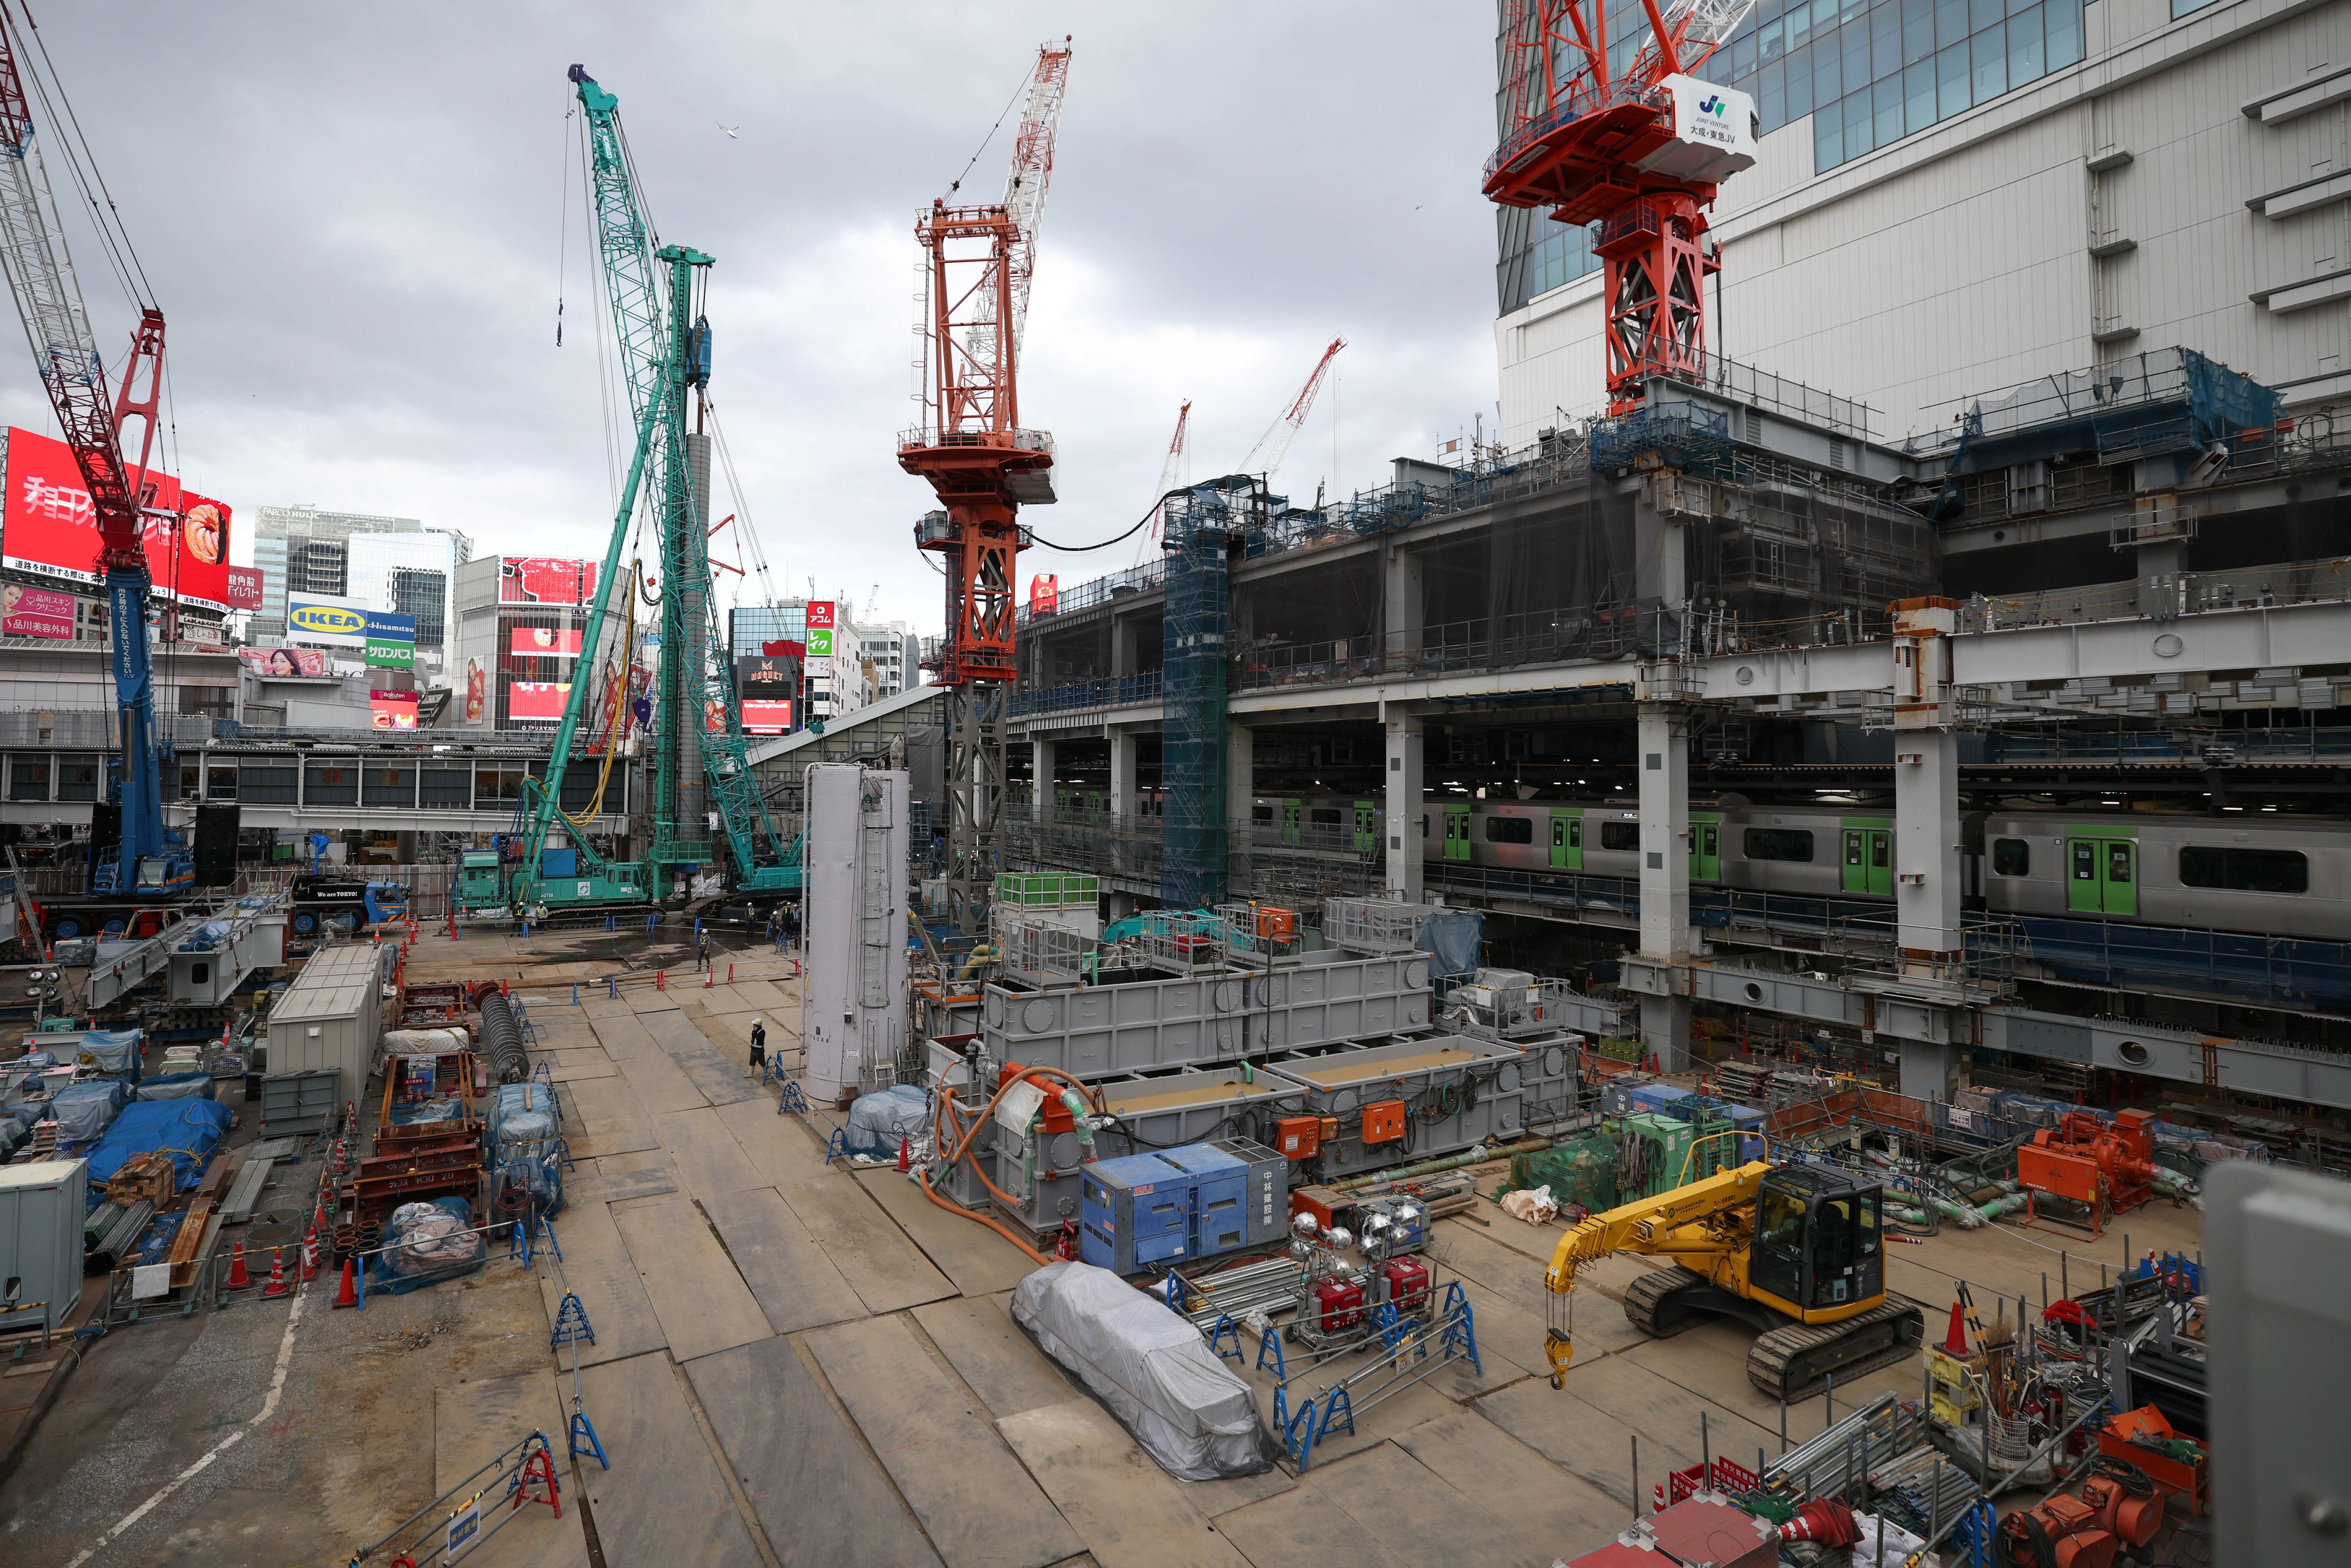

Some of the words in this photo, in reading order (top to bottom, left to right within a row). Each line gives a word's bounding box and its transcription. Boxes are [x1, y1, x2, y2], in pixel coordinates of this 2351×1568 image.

[1710, 120, 1730, 130] VENTURE
[1690, 125, 1735, 143] 大成・東急JV
[262, 507, 290, 517] PARCO
[292, 511, 320, 519] HULIC
[228, 574, 255, 587] 龍角散
[36, 594, 71, 606] 品川スキン
[36, 603, 67, 614] クリニック
[298, 611, 360, 627] IKEA
[13, 619, 69, 635] 品川美容外科
[367, 622, 414, 632] Hisamitsu
[809, 640, 827, 649] イク
[368, 646, 412, 659] サロンパス
[751, 671, 783, 681] MAGNET
